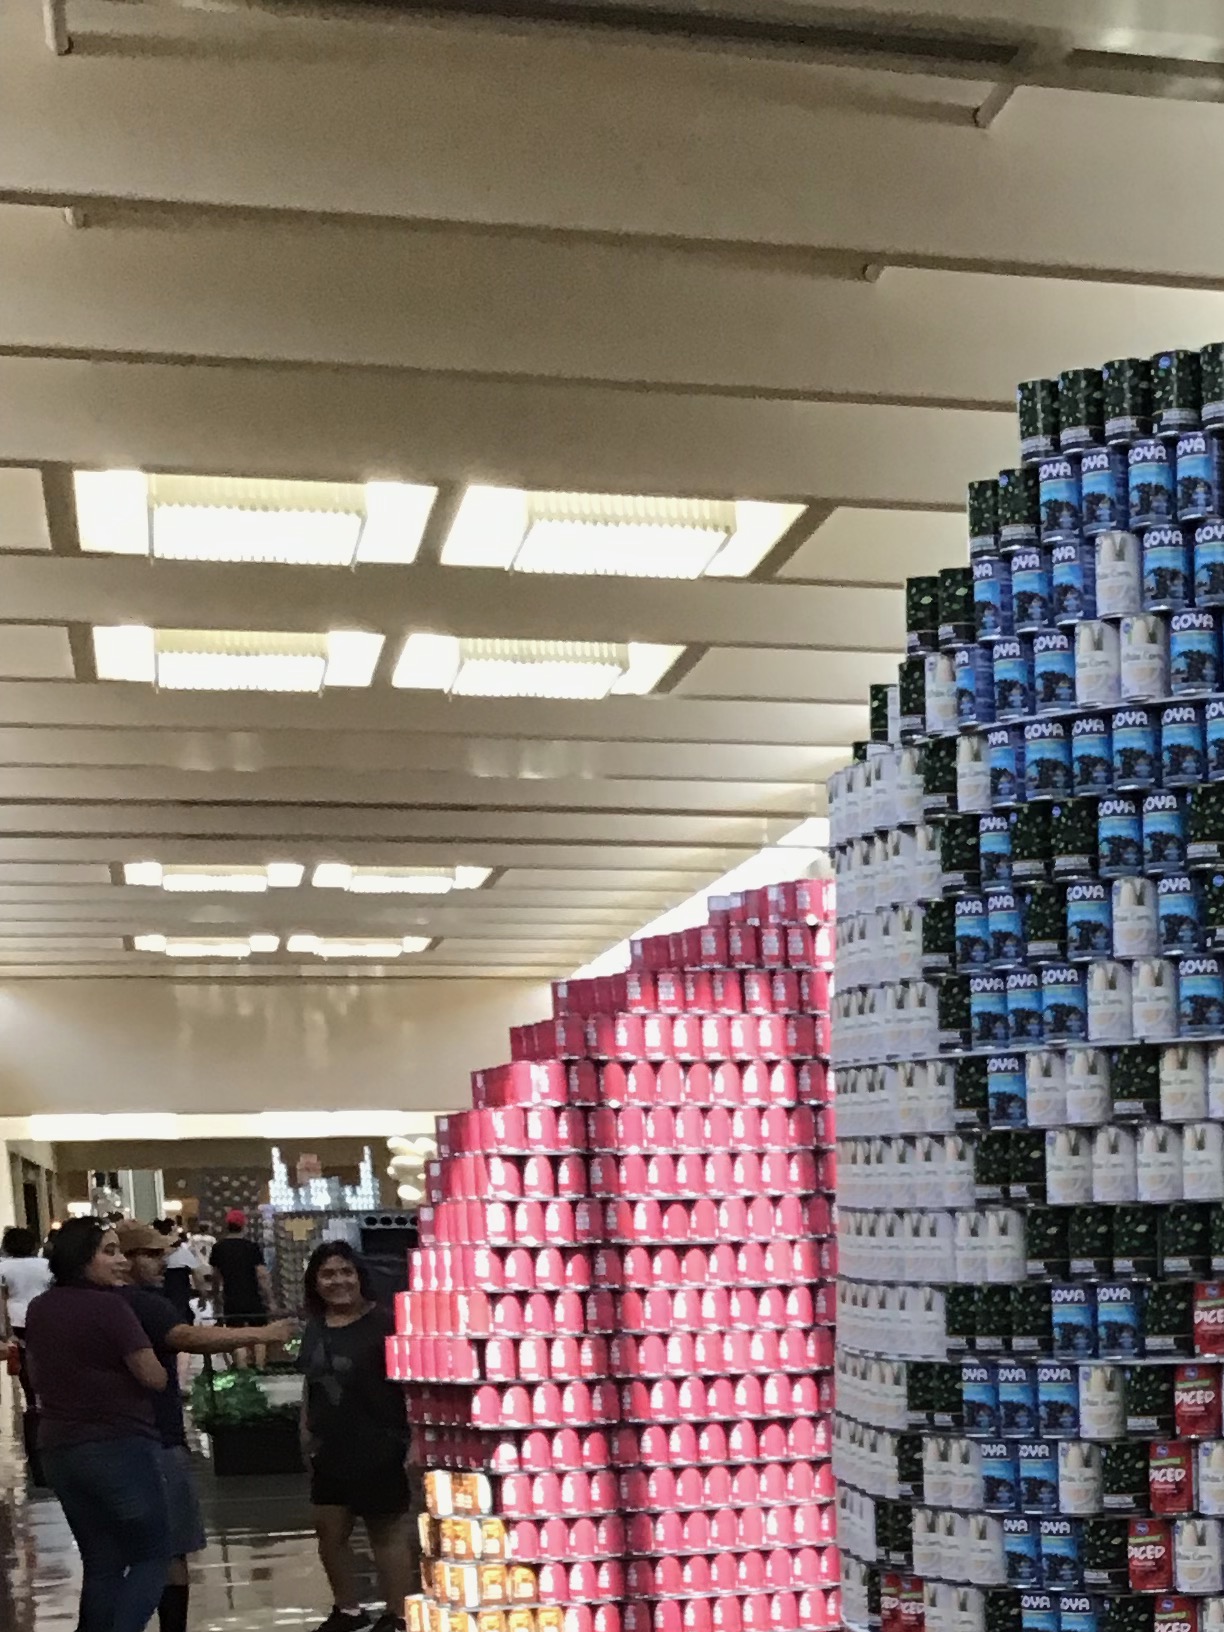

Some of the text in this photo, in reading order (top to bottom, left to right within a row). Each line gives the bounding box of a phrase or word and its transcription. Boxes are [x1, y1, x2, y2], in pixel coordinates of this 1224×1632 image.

[1175, 1390, 1215, 1405] DICED
[1150, 1468, 1186, 1482] DICED
[1128, 1545, 1165, 1560] DICED
